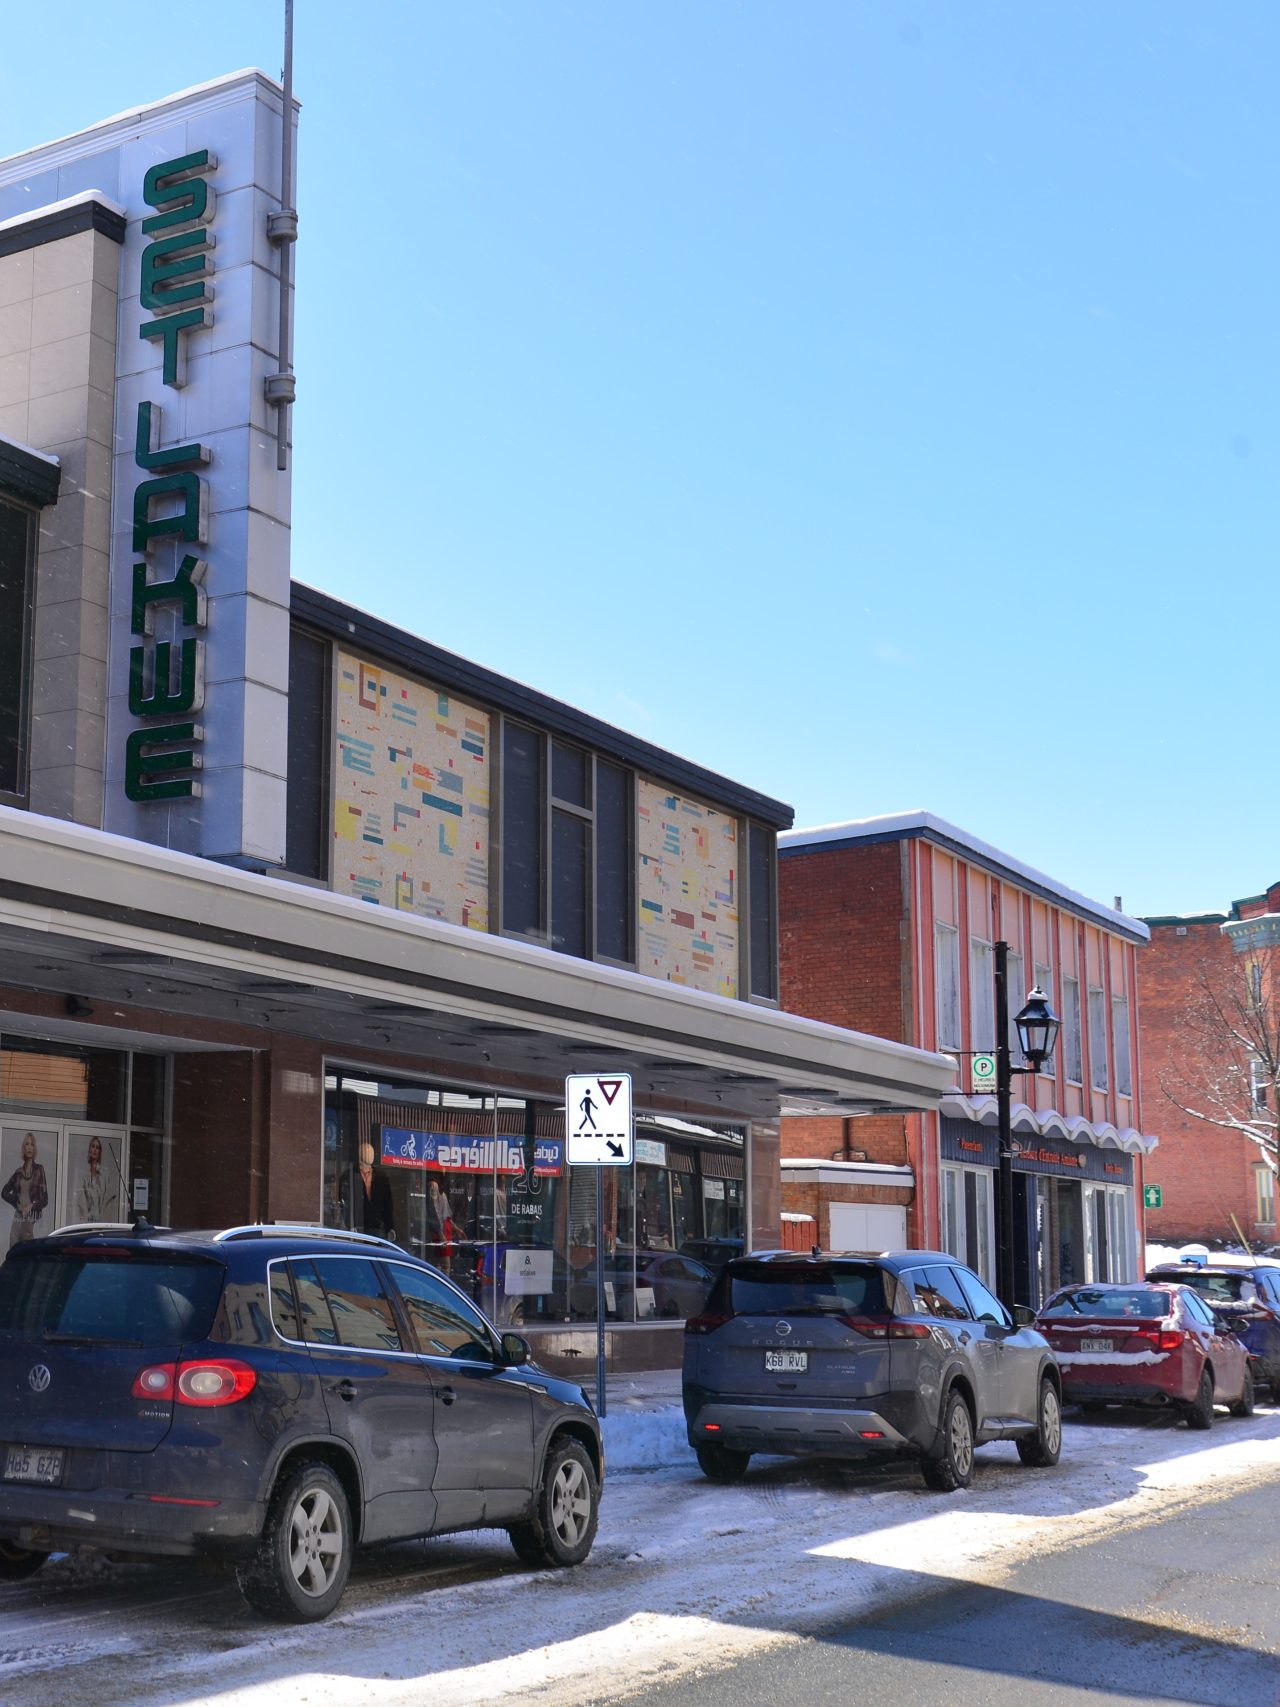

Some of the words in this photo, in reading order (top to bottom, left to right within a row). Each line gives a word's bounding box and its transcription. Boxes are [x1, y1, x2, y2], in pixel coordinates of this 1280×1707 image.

[125, 149, 212, 802] SETLAKWE
[511, 1203, 521, 1215] DE
[521, 1204, 543, 1216] RABAIS
[766, 1355, 783, 1367] K68
[788, 1356, 806, 1368] RVL
